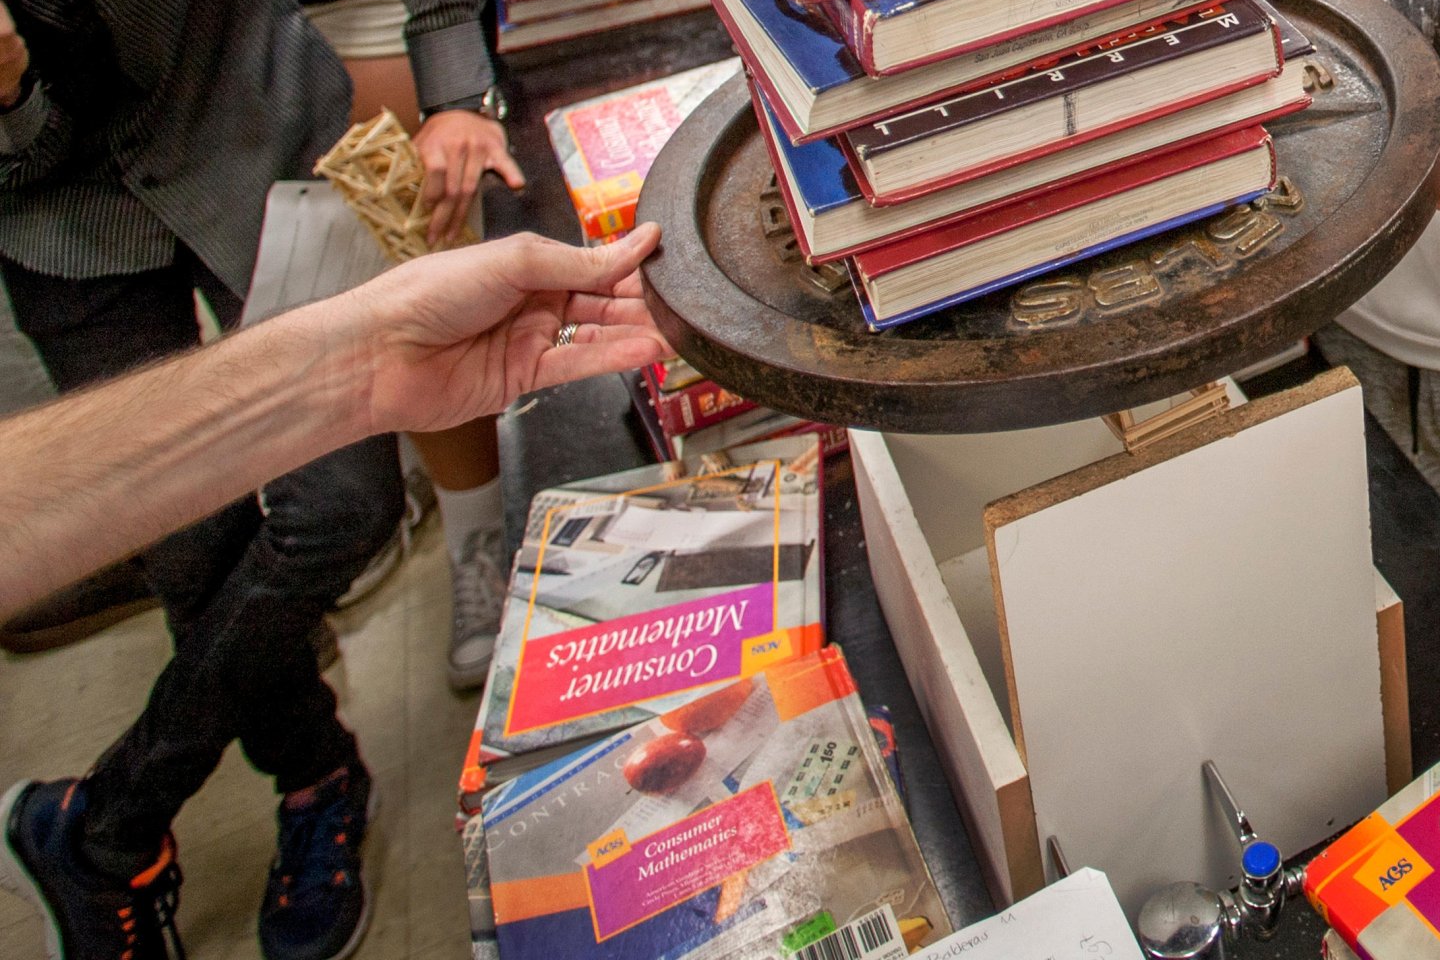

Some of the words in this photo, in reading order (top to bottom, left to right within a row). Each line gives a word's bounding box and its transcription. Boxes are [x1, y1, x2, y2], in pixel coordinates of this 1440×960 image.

[546, 600, 749, 668] Mathematics
[560, 643, 718, 702] Consumer
[637, 826, 738, 881] Mathematics
[643, 813, 723, 859] Consumer
[1377, 858, 1413, 891] AGS
